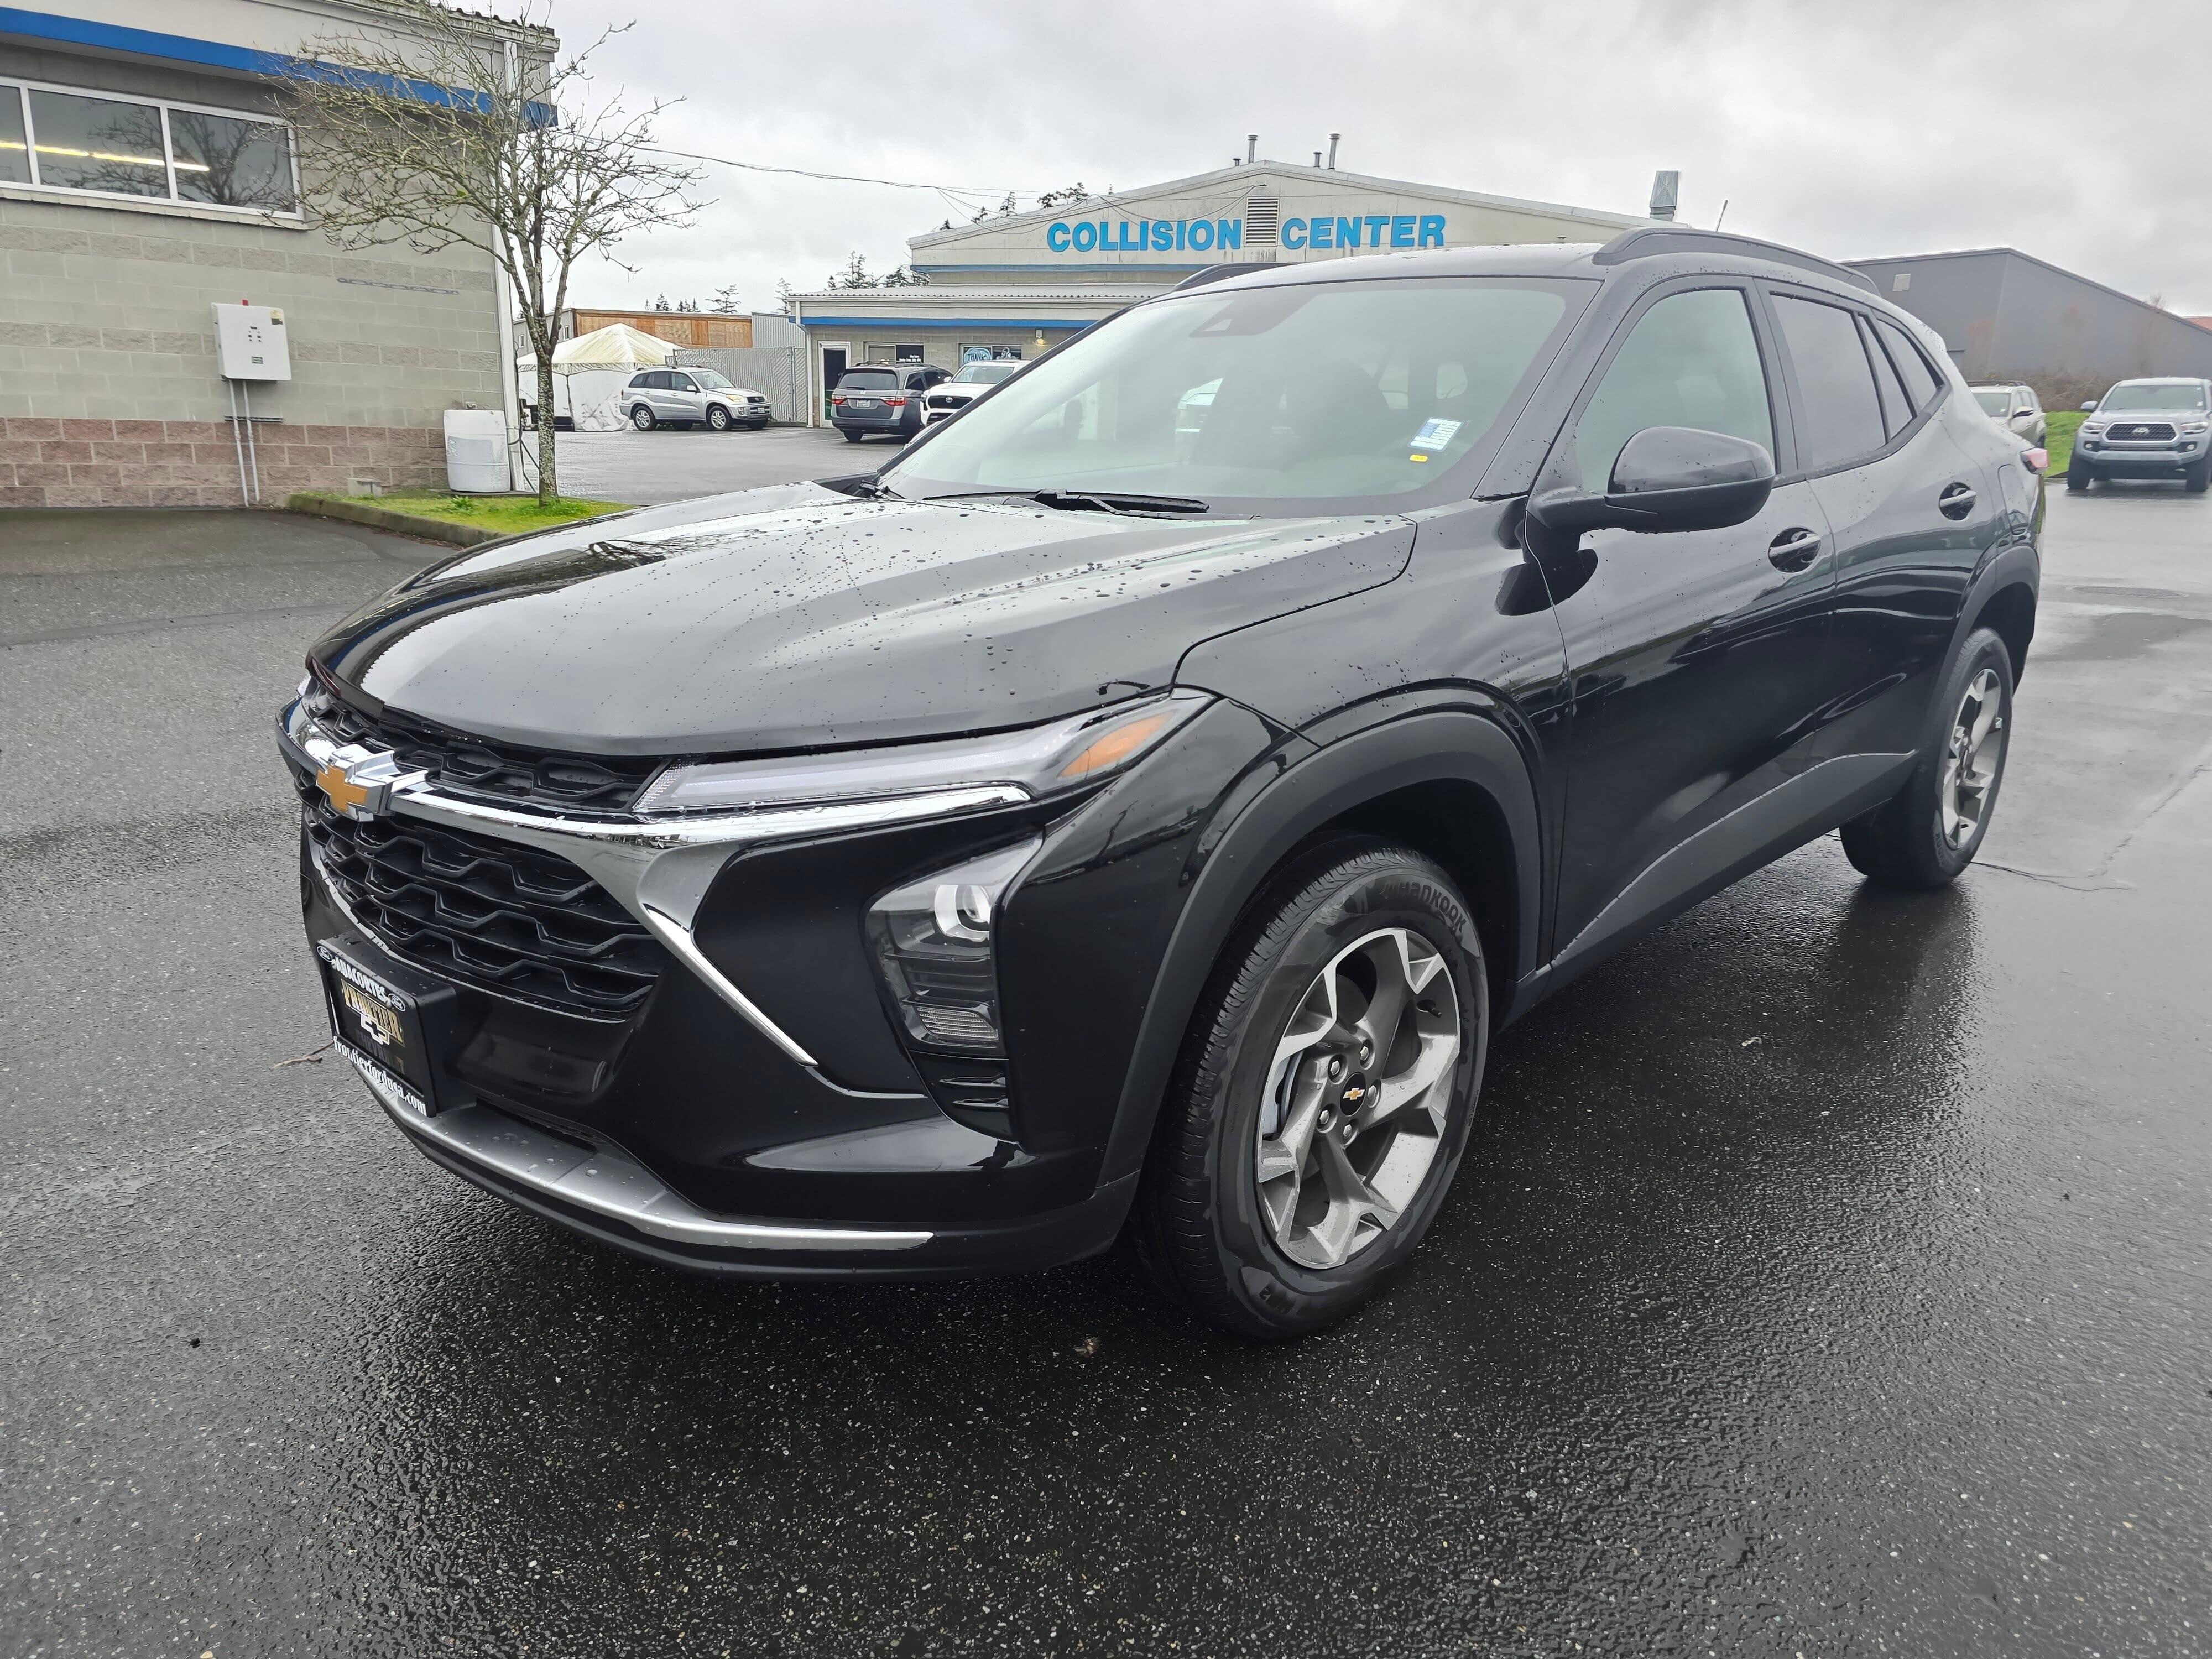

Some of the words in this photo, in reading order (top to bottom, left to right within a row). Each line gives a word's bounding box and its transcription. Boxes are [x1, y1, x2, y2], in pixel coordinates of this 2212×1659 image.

[1047, 219, 1241, 252] COLLISION
[1281, 215, 1446, 250] CENTER
[968, 352, 987, 361] THANK
[319, 947, 331, 961] Ford
[335, 956, 387, 1003] ANACORTES
[341, 978, 403, 1043] FRONTIER
[390, 994, 404, 1010] Ford
[333, 1036, 427, 1117] frontierfordusa.com
